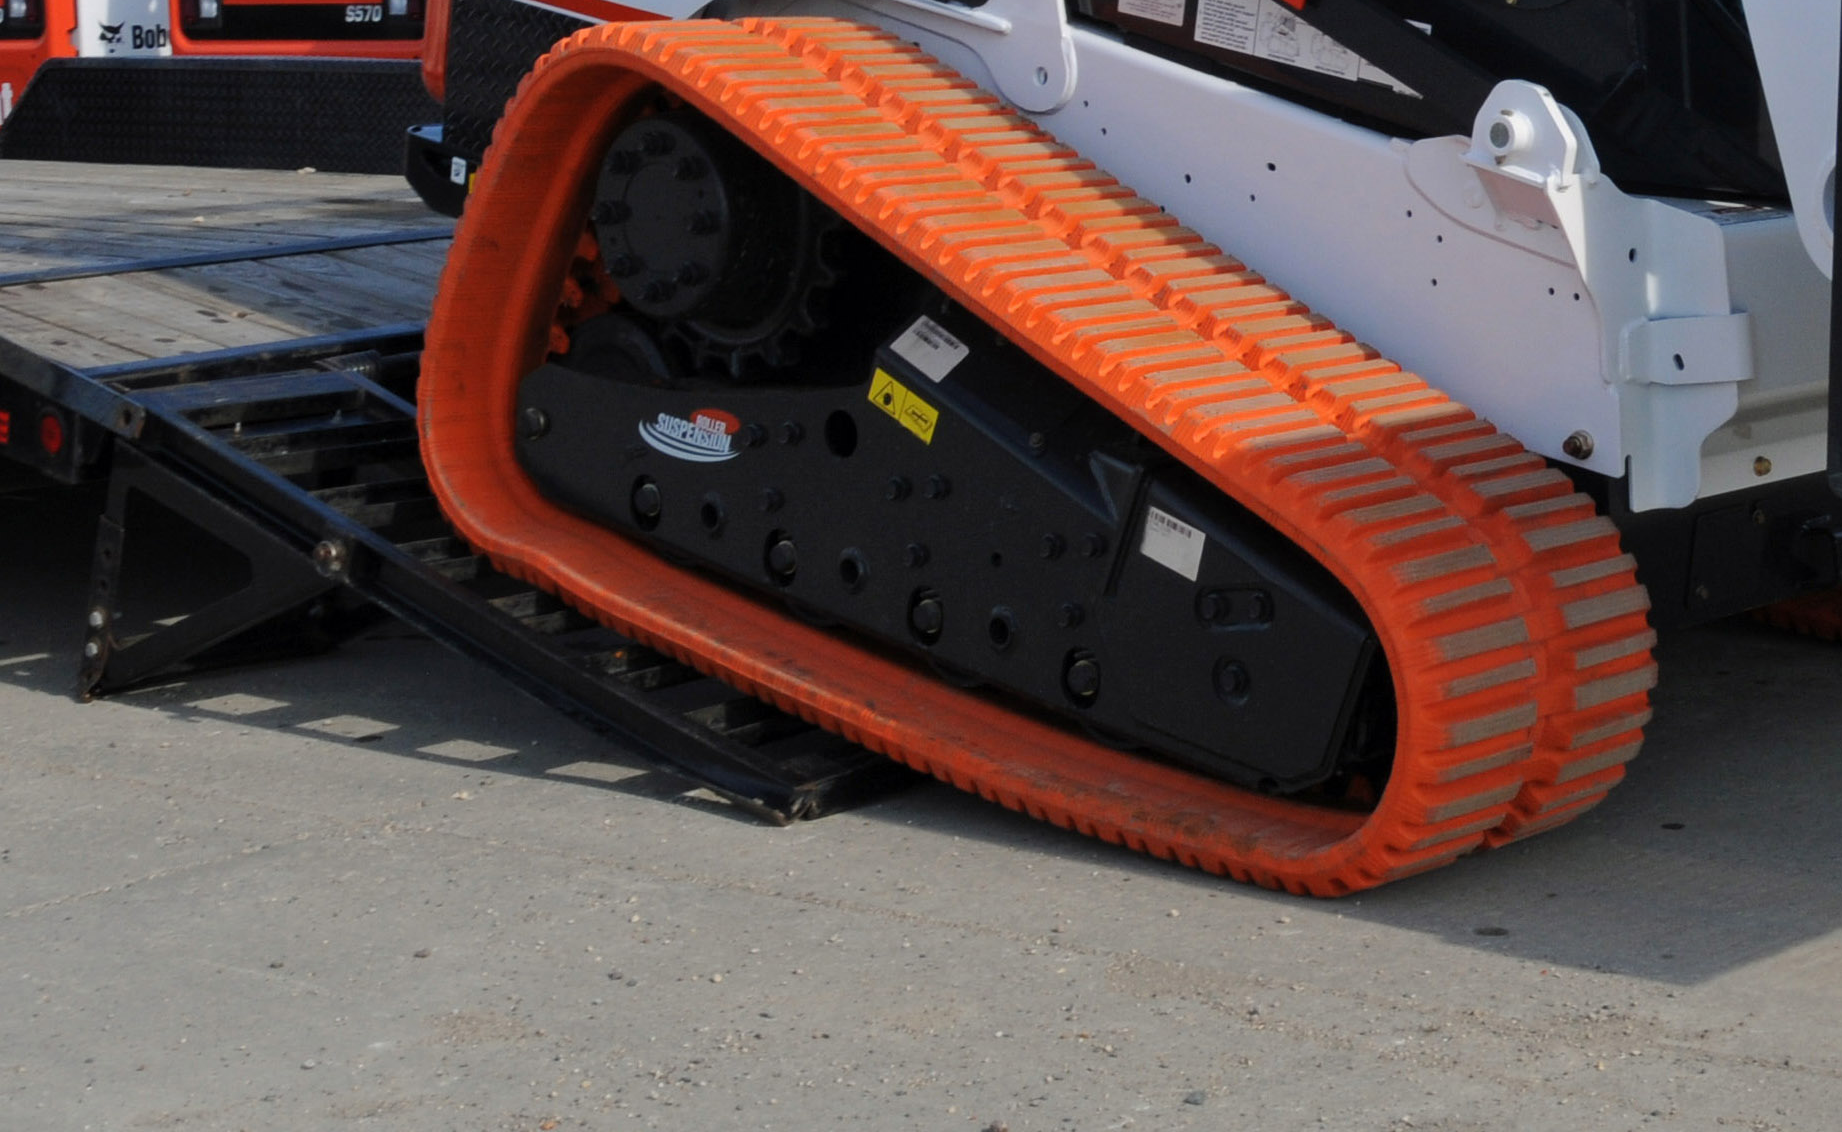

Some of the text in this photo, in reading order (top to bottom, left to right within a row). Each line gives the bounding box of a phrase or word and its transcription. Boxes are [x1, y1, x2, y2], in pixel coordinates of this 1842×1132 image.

[345, 5, 383, 23] S570
[131, 24, 168, 49] Bob
[655, 412, 732, 453] SUSPENSION
[695, 414, 726, 435] ROLLER
